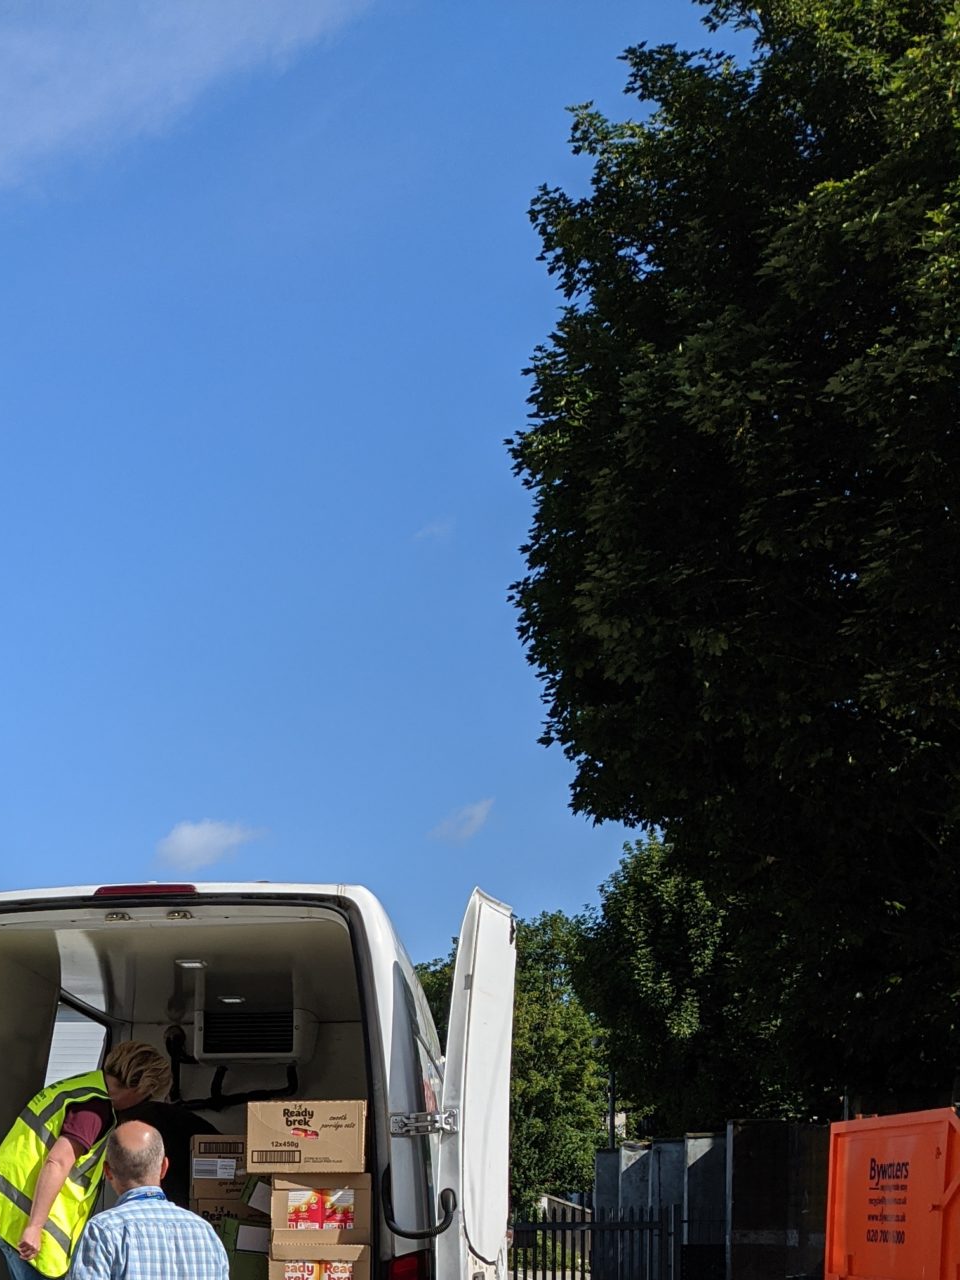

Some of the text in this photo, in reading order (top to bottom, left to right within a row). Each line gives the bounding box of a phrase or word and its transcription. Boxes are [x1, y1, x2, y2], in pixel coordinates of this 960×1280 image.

[282, 1108, 314, 1119] Ready
[285, 1118, 312, 1127] brek
[869, 1158, 909, 1186] Bywaters
[866, 1229, 879, 1243] 020
[284, 1262, 314, 1275] eady
[324, 1262, 353, 1275] Rea
